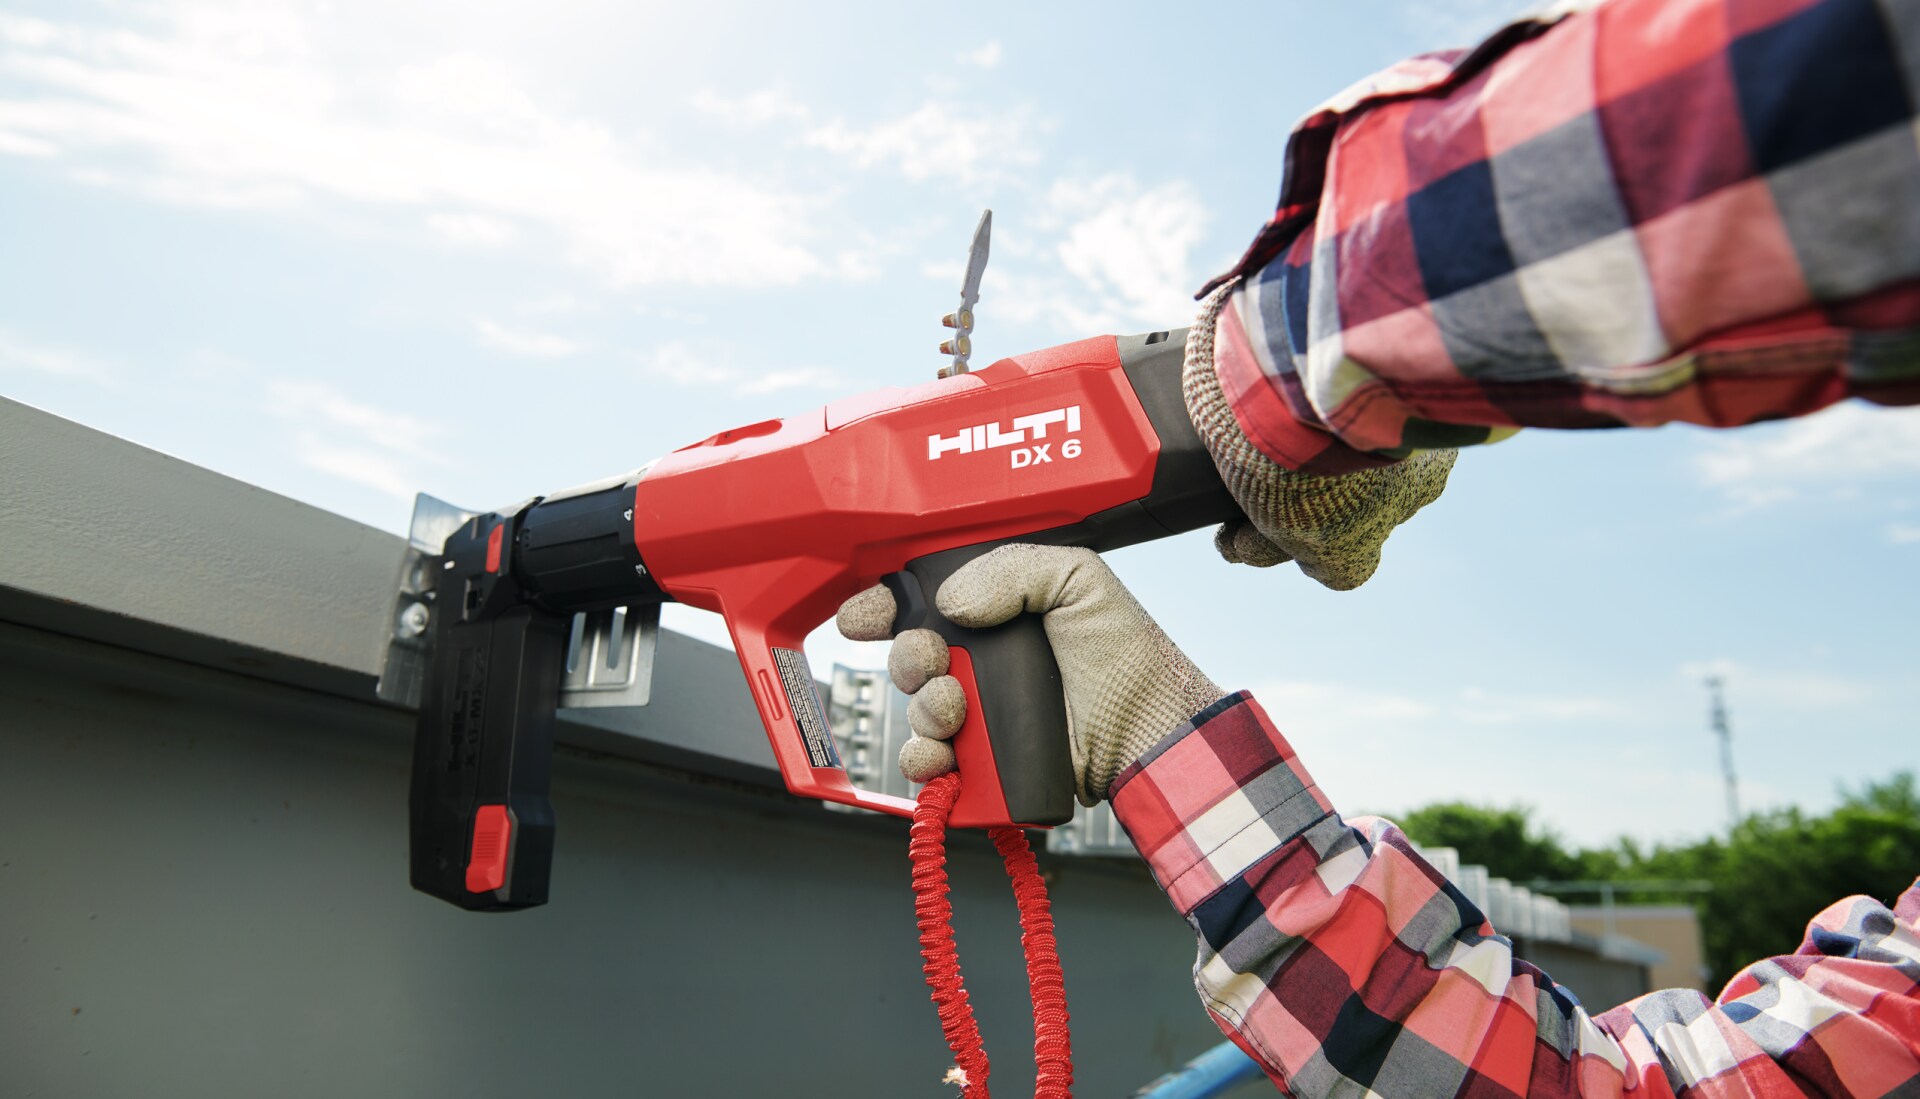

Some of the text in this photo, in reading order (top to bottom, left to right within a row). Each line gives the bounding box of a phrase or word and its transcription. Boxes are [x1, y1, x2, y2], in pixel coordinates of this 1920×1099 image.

[928, 405, 1081, 461] HILTI
[1011, 439, 1082, 469] DX 6
[623, 508, 633, 521] 4
[635, 563, 647, 576] 3
